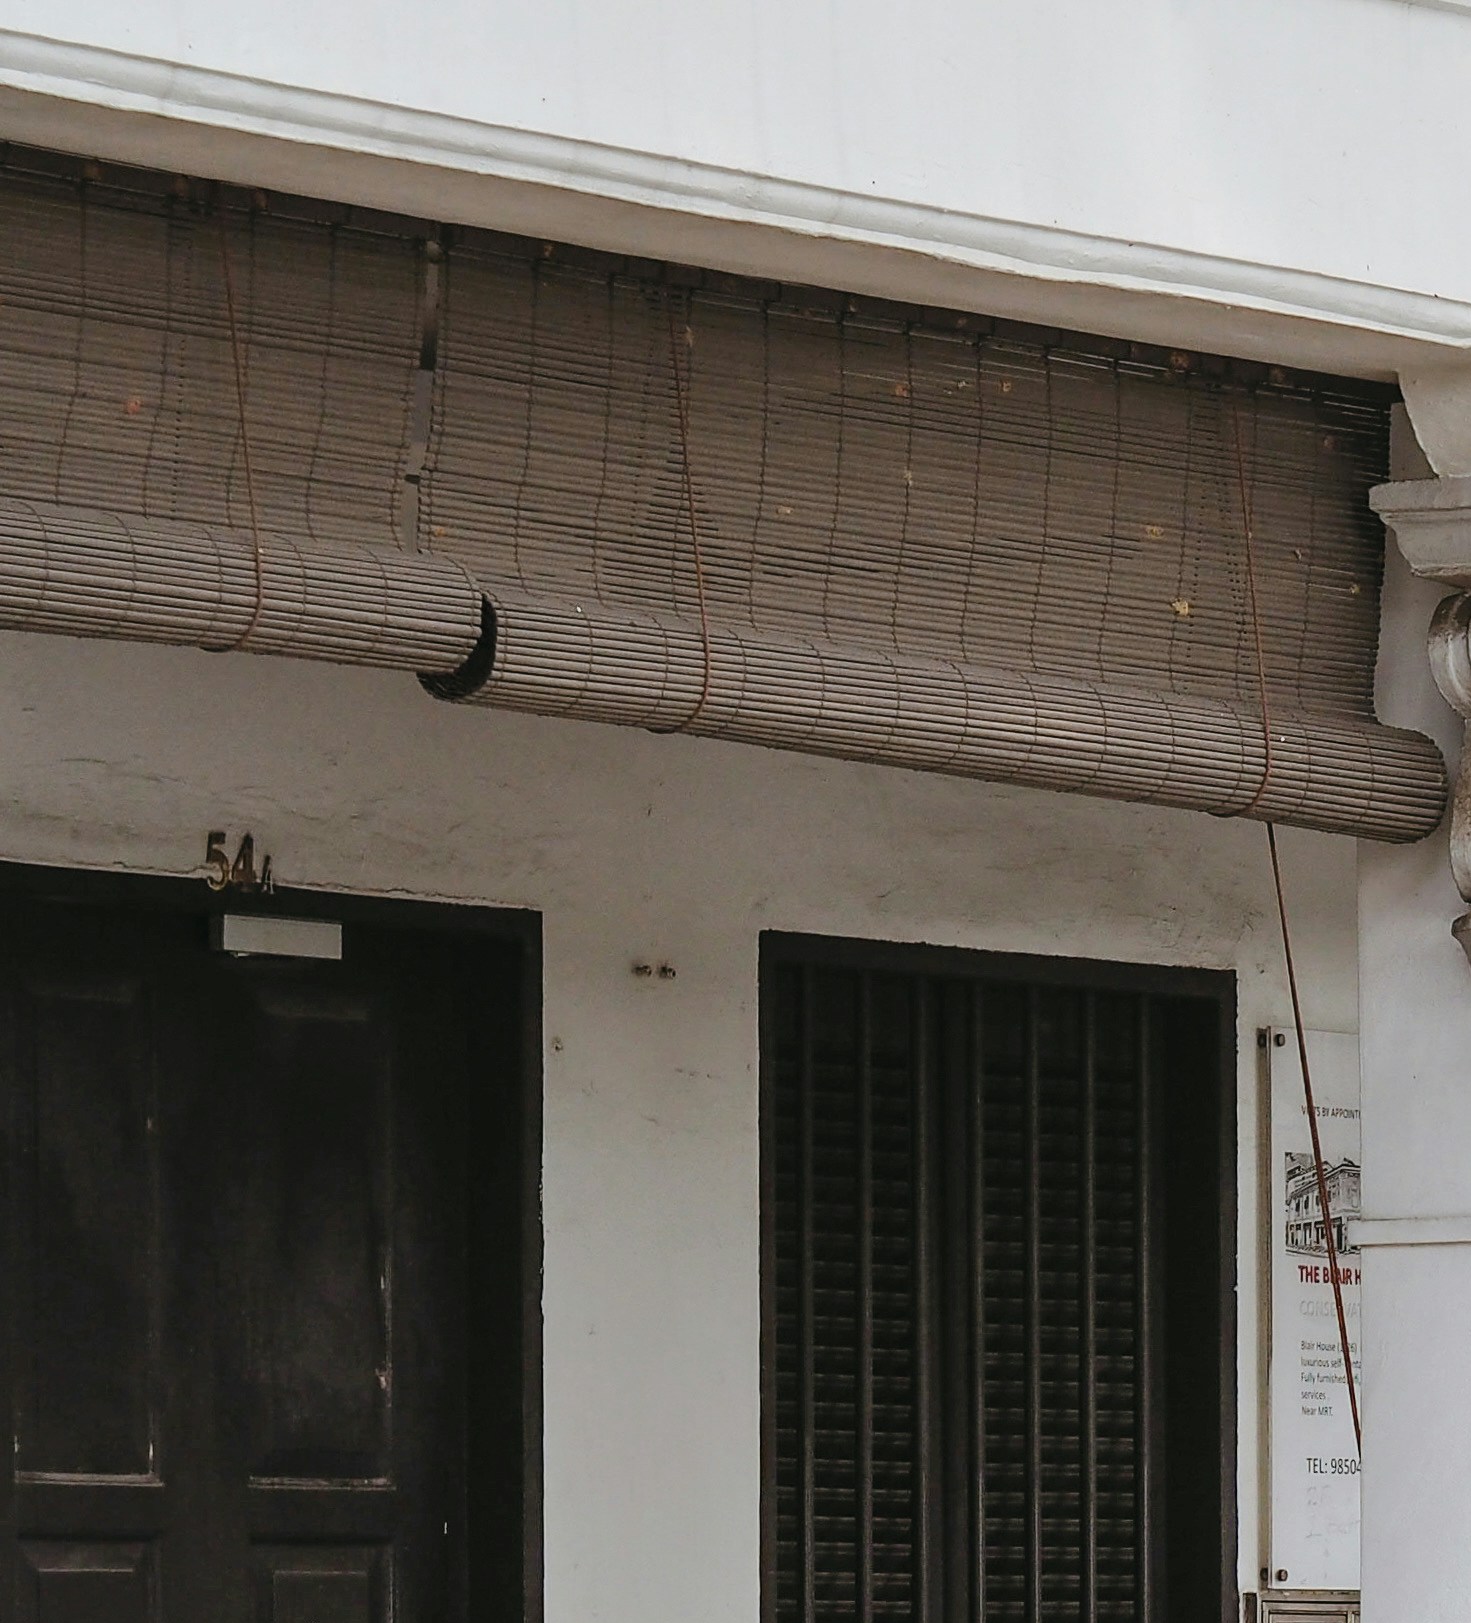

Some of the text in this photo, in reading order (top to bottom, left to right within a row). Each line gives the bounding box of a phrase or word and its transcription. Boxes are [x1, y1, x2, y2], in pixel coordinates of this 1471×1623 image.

[1298, 1265, 1320, 1283] THE
[1316, 1342, 1336, 1351] House
[1301, 1372, 1315, 1384] Fully
[1302, 1406, 1317, 1416] Near
[1306, 1457, 1328, 1474] TEL:
